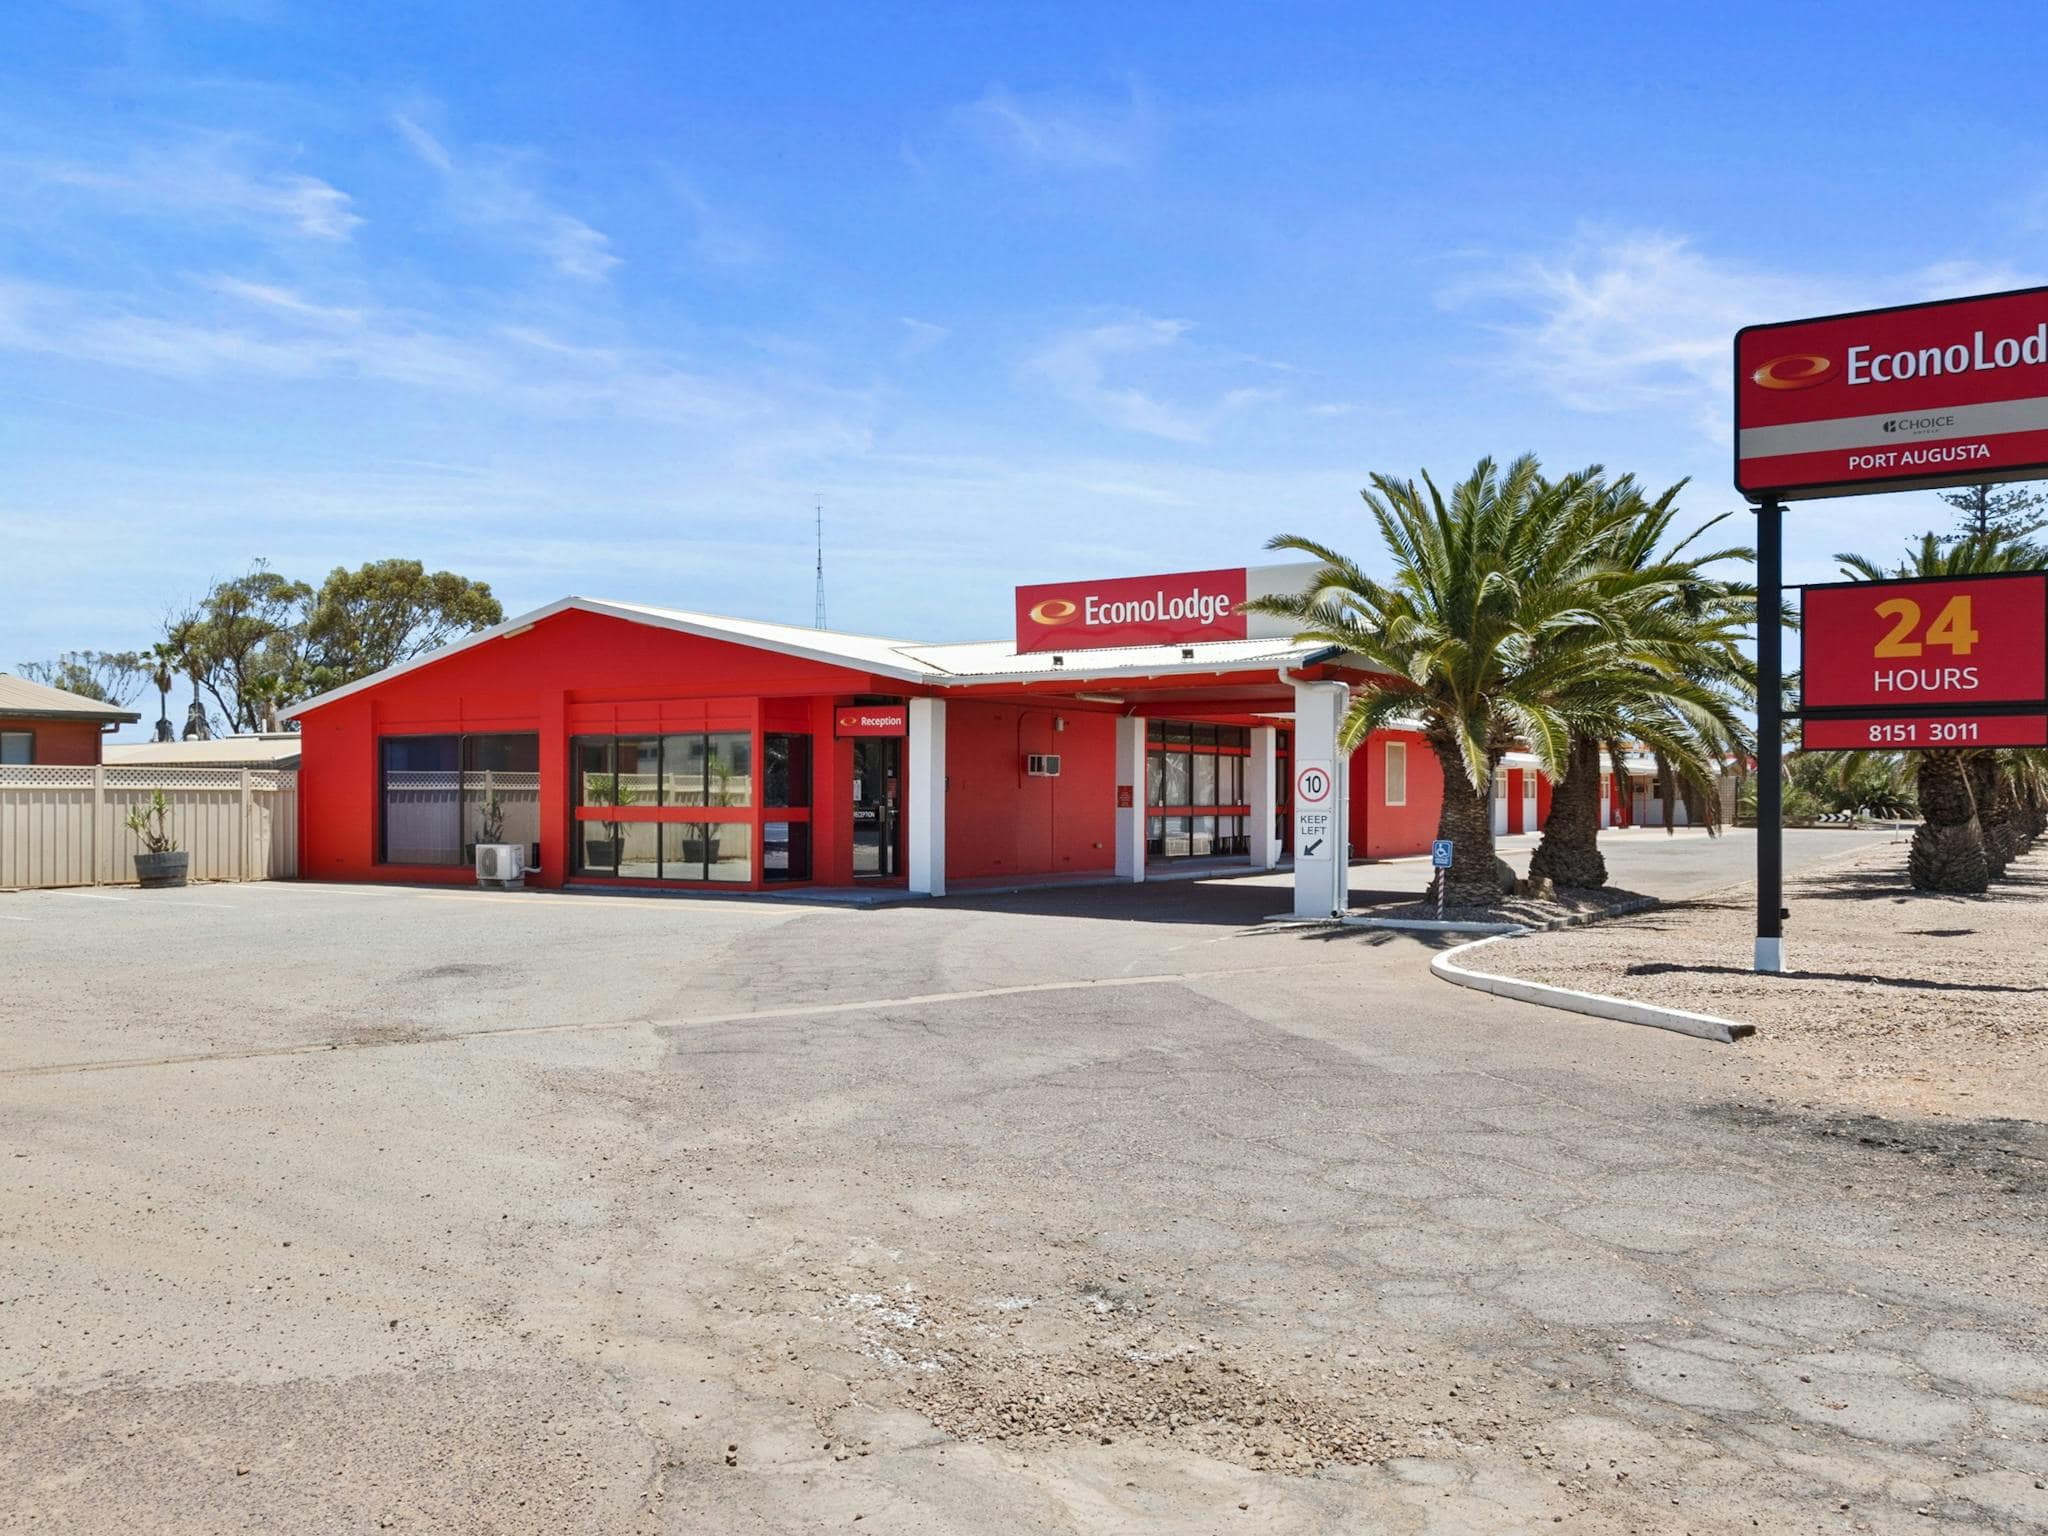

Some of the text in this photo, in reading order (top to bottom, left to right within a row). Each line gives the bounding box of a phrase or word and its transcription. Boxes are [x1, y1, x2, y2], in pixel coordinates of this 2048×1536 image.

[1847, 323, 2047, 385] EconoLod
[1898, 416, 1955, 430] CHOICE
[1849, 444, 1990, 470] PORT AUGUSTA
[1085, 588, 1230, 625] EconoLodge
[1873, 595, 1979, 658] 24
[1874, 667, 1979, 692] HOURS
[861, 716, 902, 728] Reception
[1869, 723, 1979, 741] 8151 3011
[1305, 775, 1322, 794] 10
[1300, 815, 1328, 824] KEEP
[1301, 827, 1326, 835] LEFT
